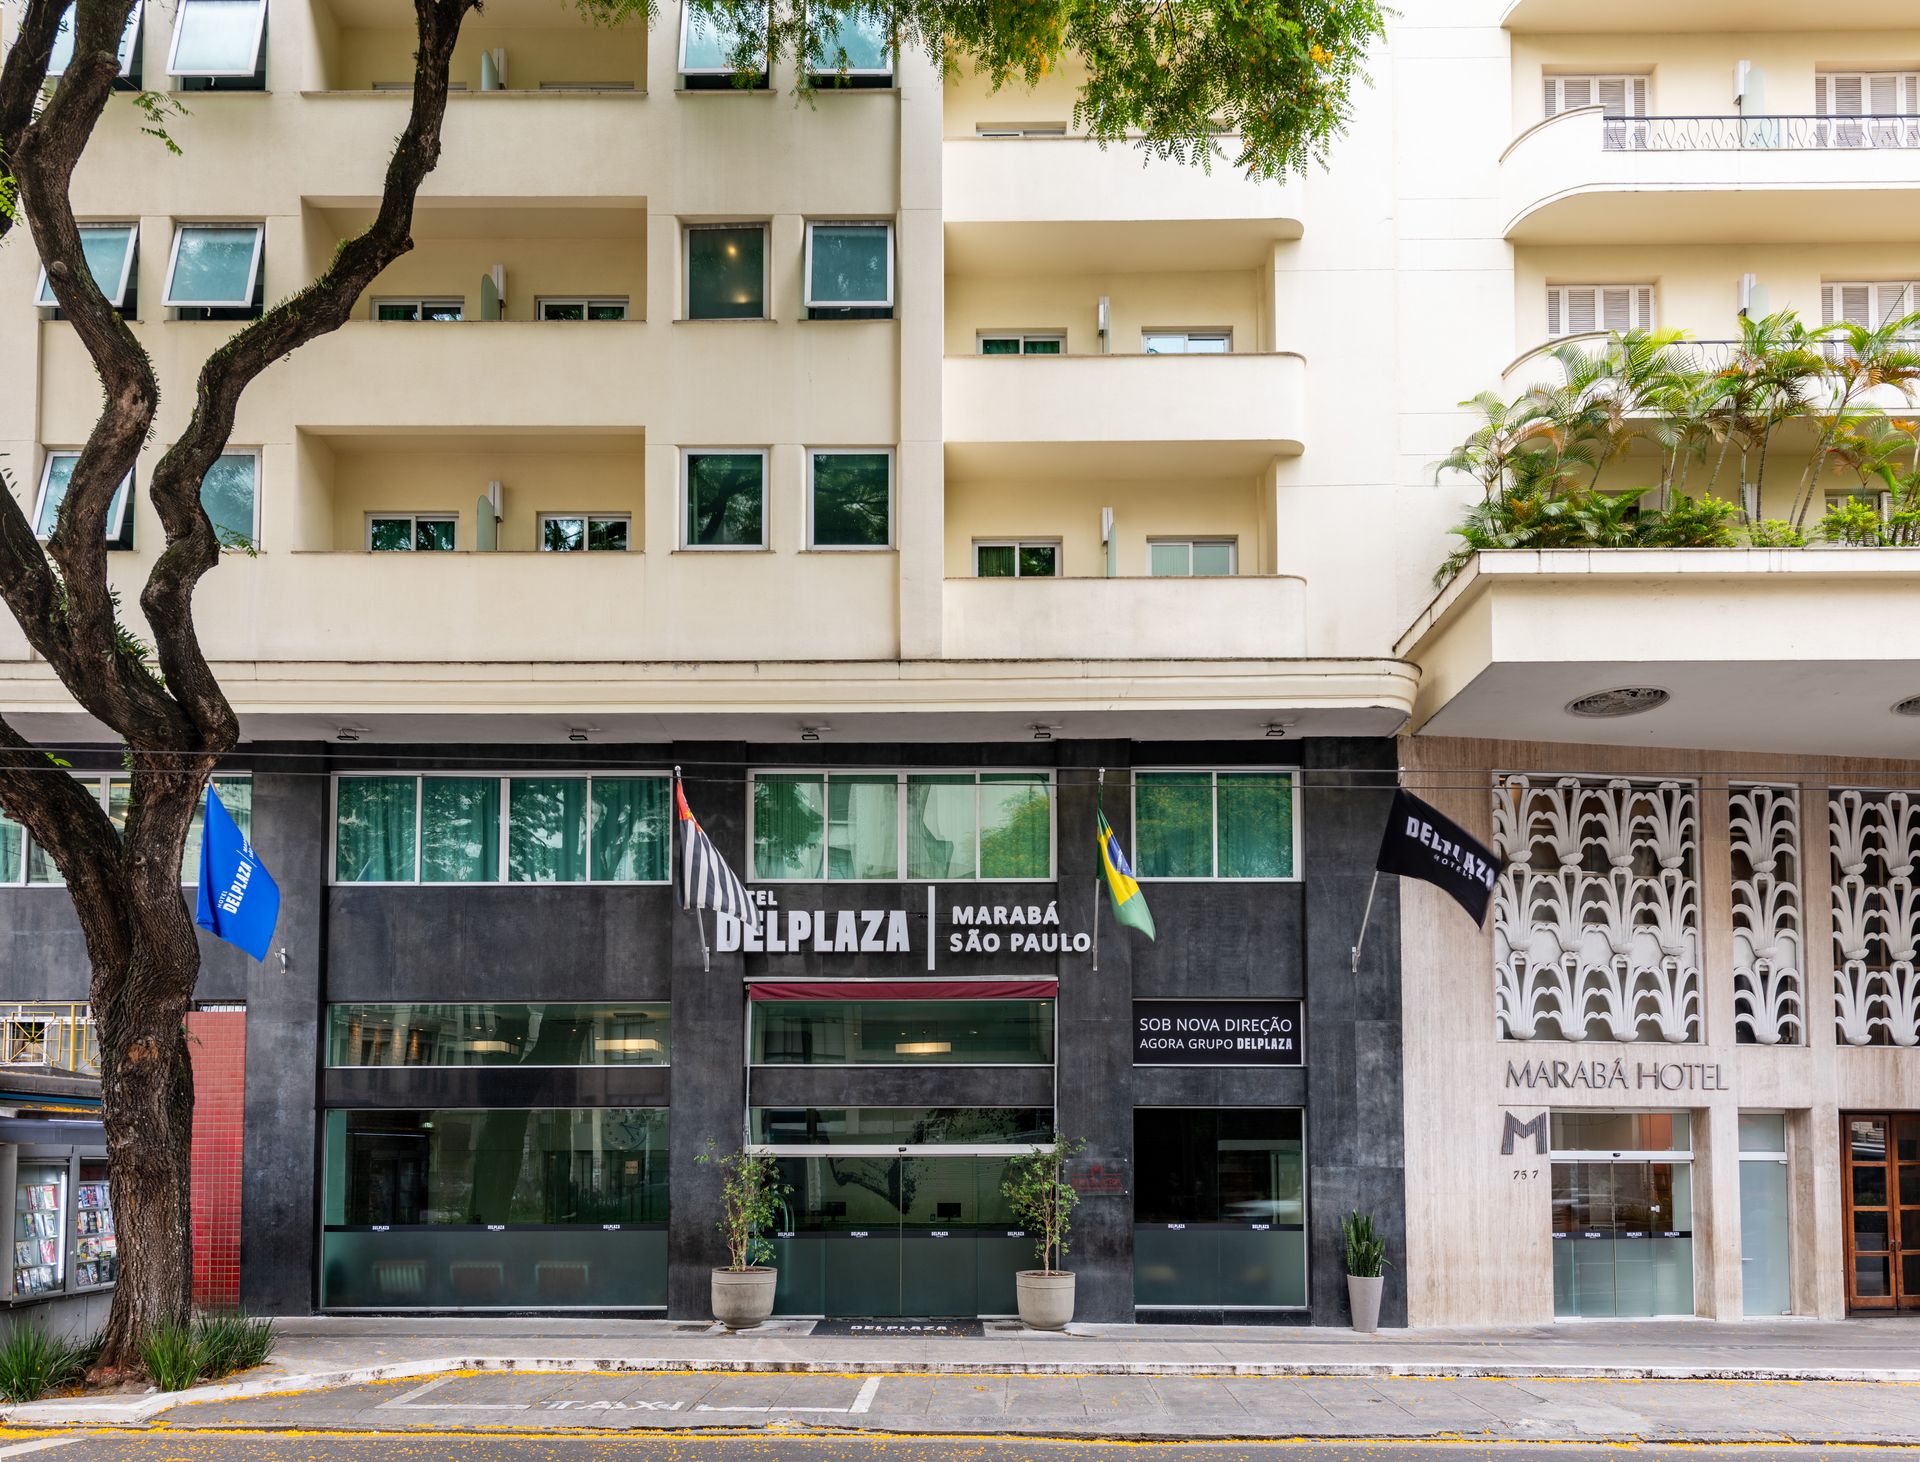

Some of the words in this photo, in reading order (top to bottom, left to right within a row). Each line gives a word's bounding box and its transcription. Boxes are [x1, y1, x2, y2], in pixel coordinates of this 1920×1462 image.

[222, 861, 252, 914] DELPLAZA
[952, 901, 1060, 925] MARABÁ
[716, 910, 910, 952] DELPLAZA
[950, 929, 1001, 952] SÃO
[1010, 933, 1091, 952] PAULO
[1140, 1018, 1171, 1031] SOB
[1176, 1018, 1220, 1032] NOVA
[1225, 1016, 1292, 1035] DIREÇÃO
[1140, 1038, 1184, 1049] AGORA
[1188, 1039, 1233, 1049] GRUPO
[1237, 1038, 1293, 1050] DELPLAZA
[1506, 1057, 1629, 1089] MARABÁ
[1637, 1063, 1729, 1090] HOTEL
